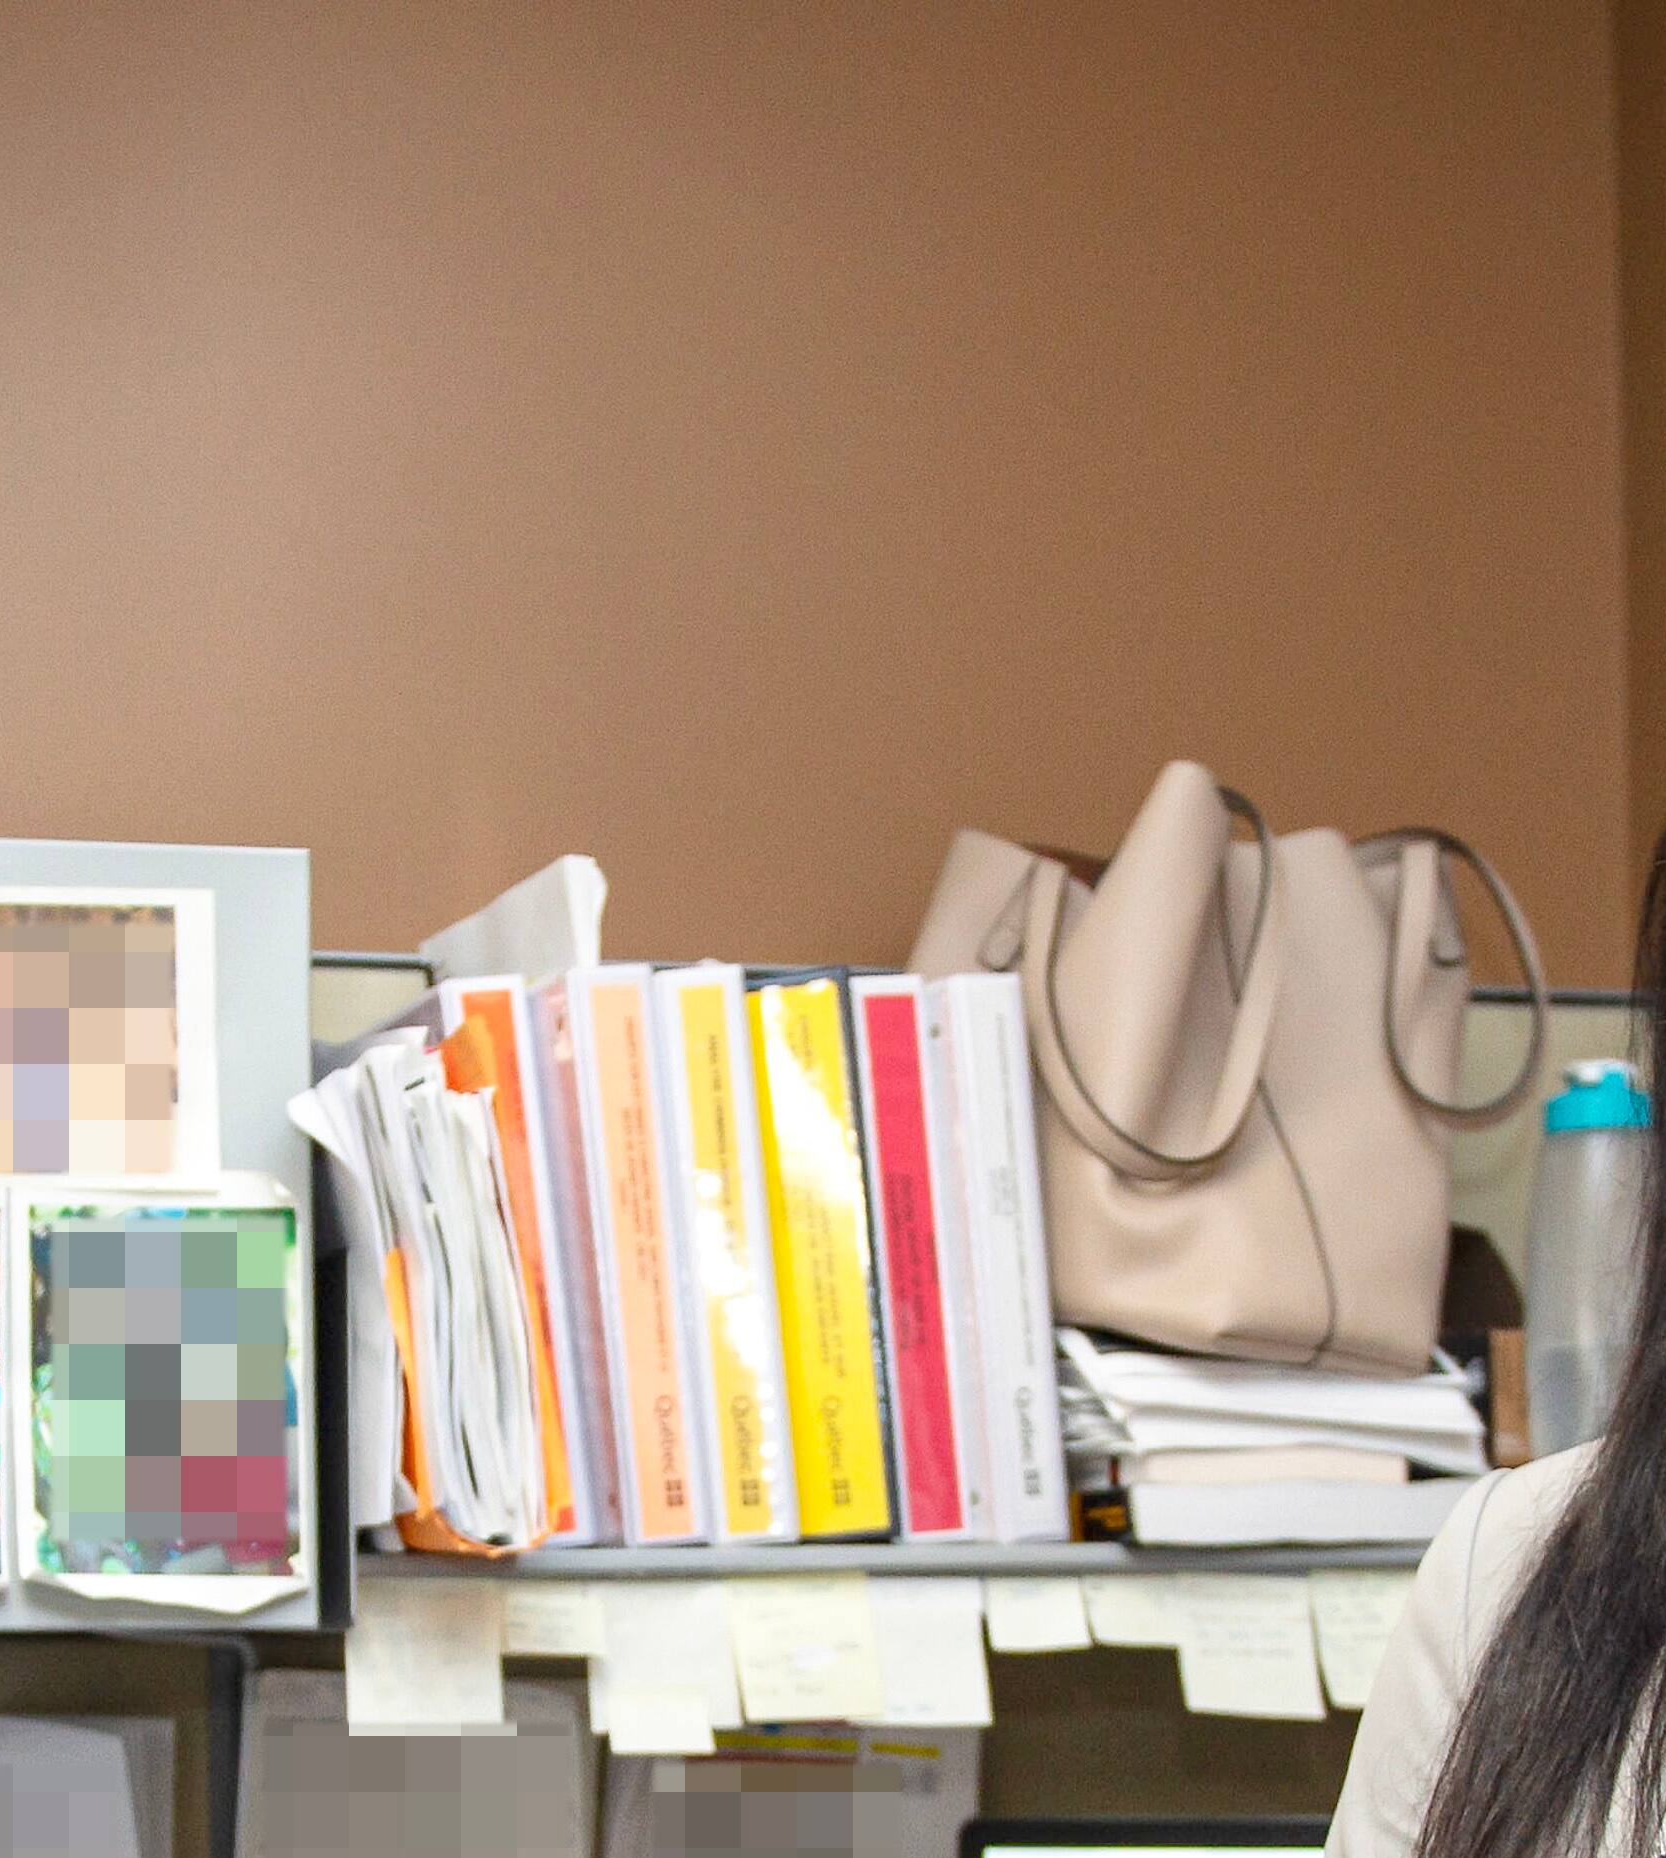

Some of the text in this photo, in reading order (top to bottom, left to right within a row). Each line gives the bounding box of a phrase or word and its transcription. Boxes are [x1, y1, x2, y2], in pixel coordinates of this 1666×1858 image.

[652, 1395, 679, 1474] Québec
[729, 1395, 754, 1473] Québec
[818, 1395, 845, 1473] Québec
[1013, 1385, 1039, 1465] Québec
